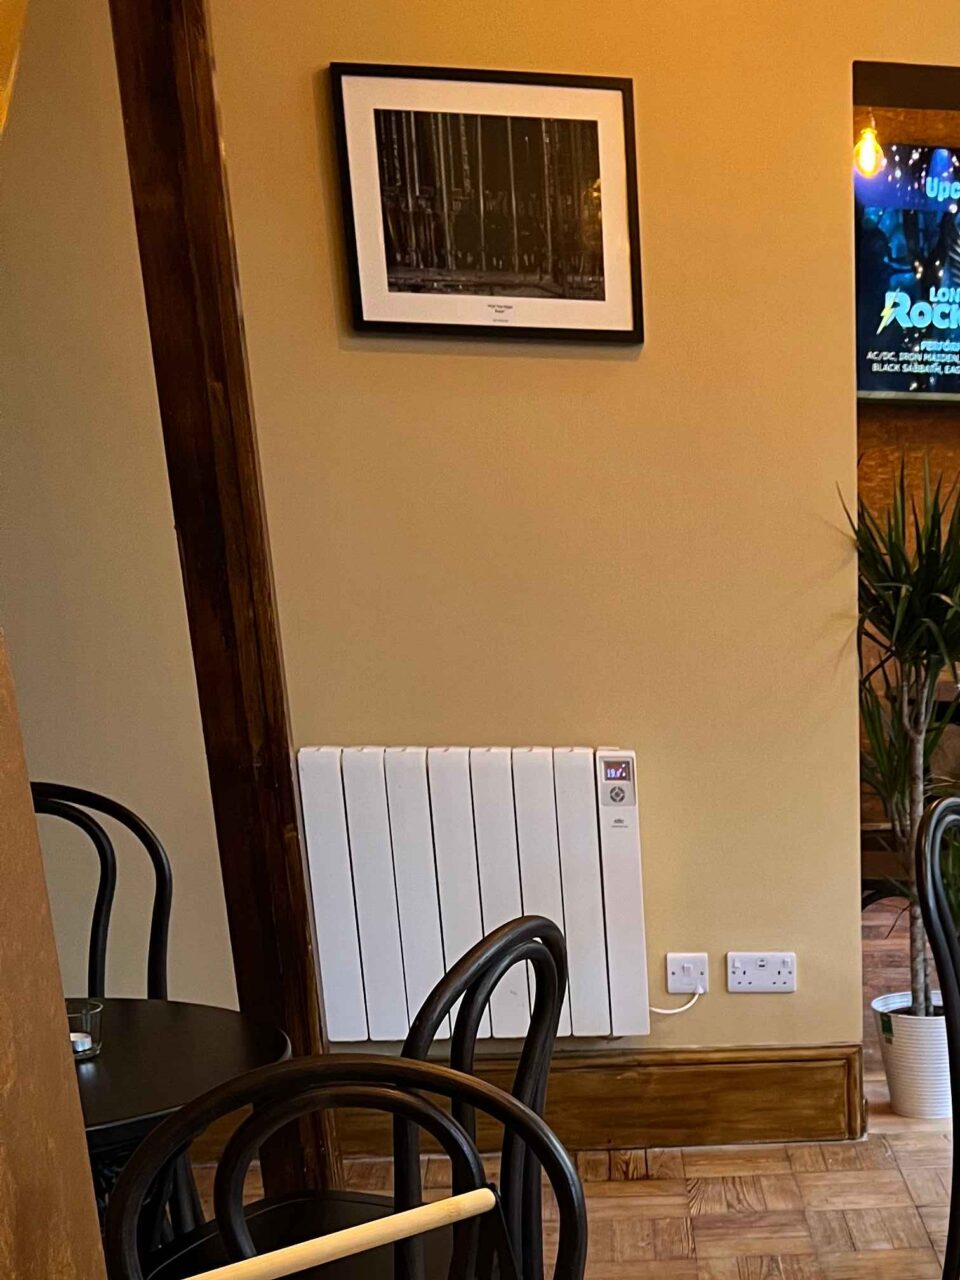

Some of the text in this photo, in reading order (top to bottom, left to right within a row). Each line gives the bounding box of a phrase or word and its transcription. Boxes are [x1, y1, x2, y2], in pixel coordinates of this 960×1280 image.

[866, 351, 897, 362] AC/DC,
[899, 352, 922, 361] IRON
[872, 363, 900, 372] BLACK
